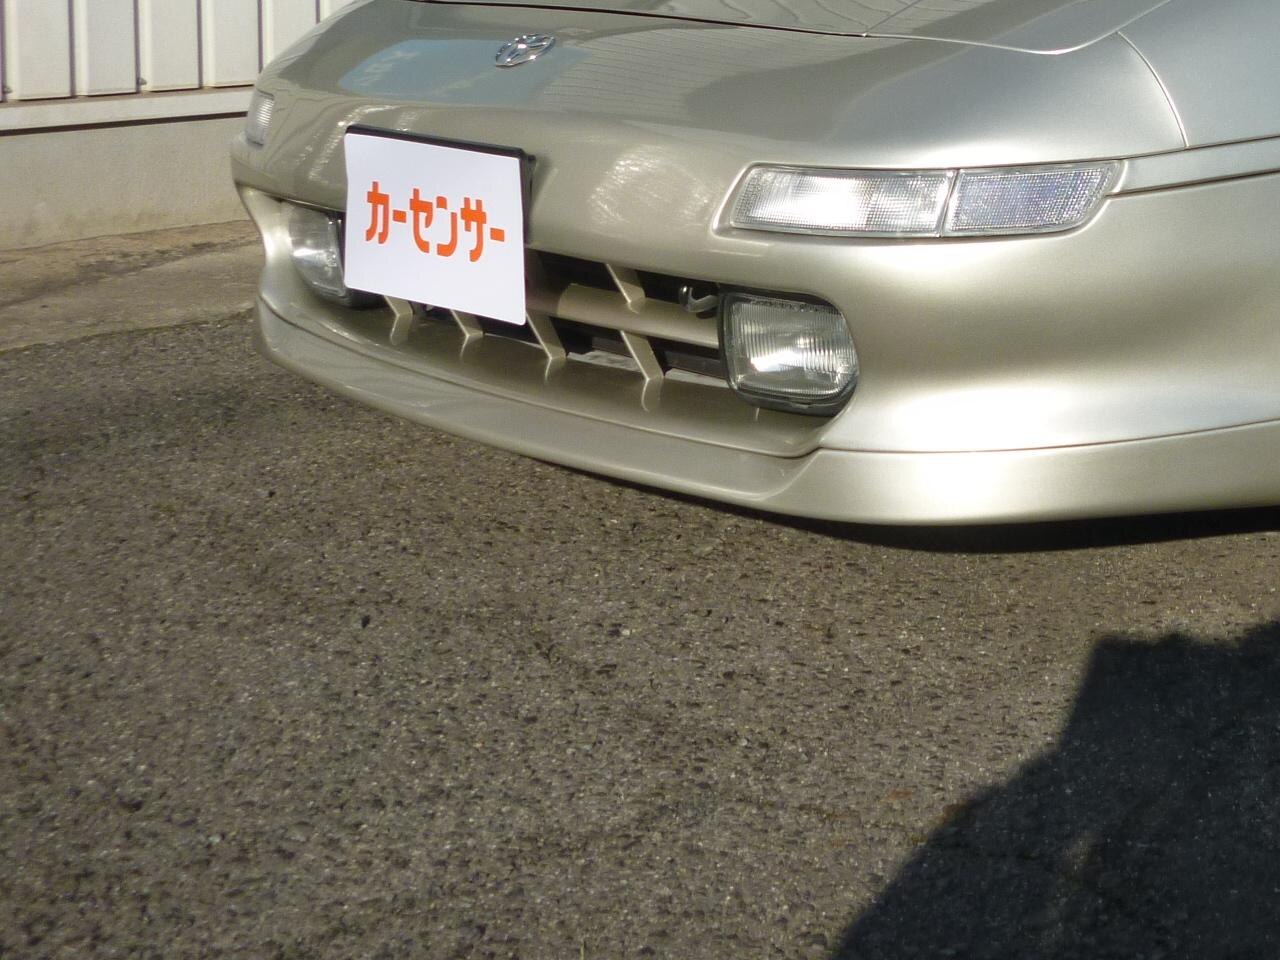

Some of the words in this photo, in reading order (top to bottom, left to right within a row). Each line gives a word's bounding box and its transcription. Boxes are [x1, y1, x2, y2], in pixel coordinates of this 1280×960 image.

[365, 181, 505, 262] カーセンサー
